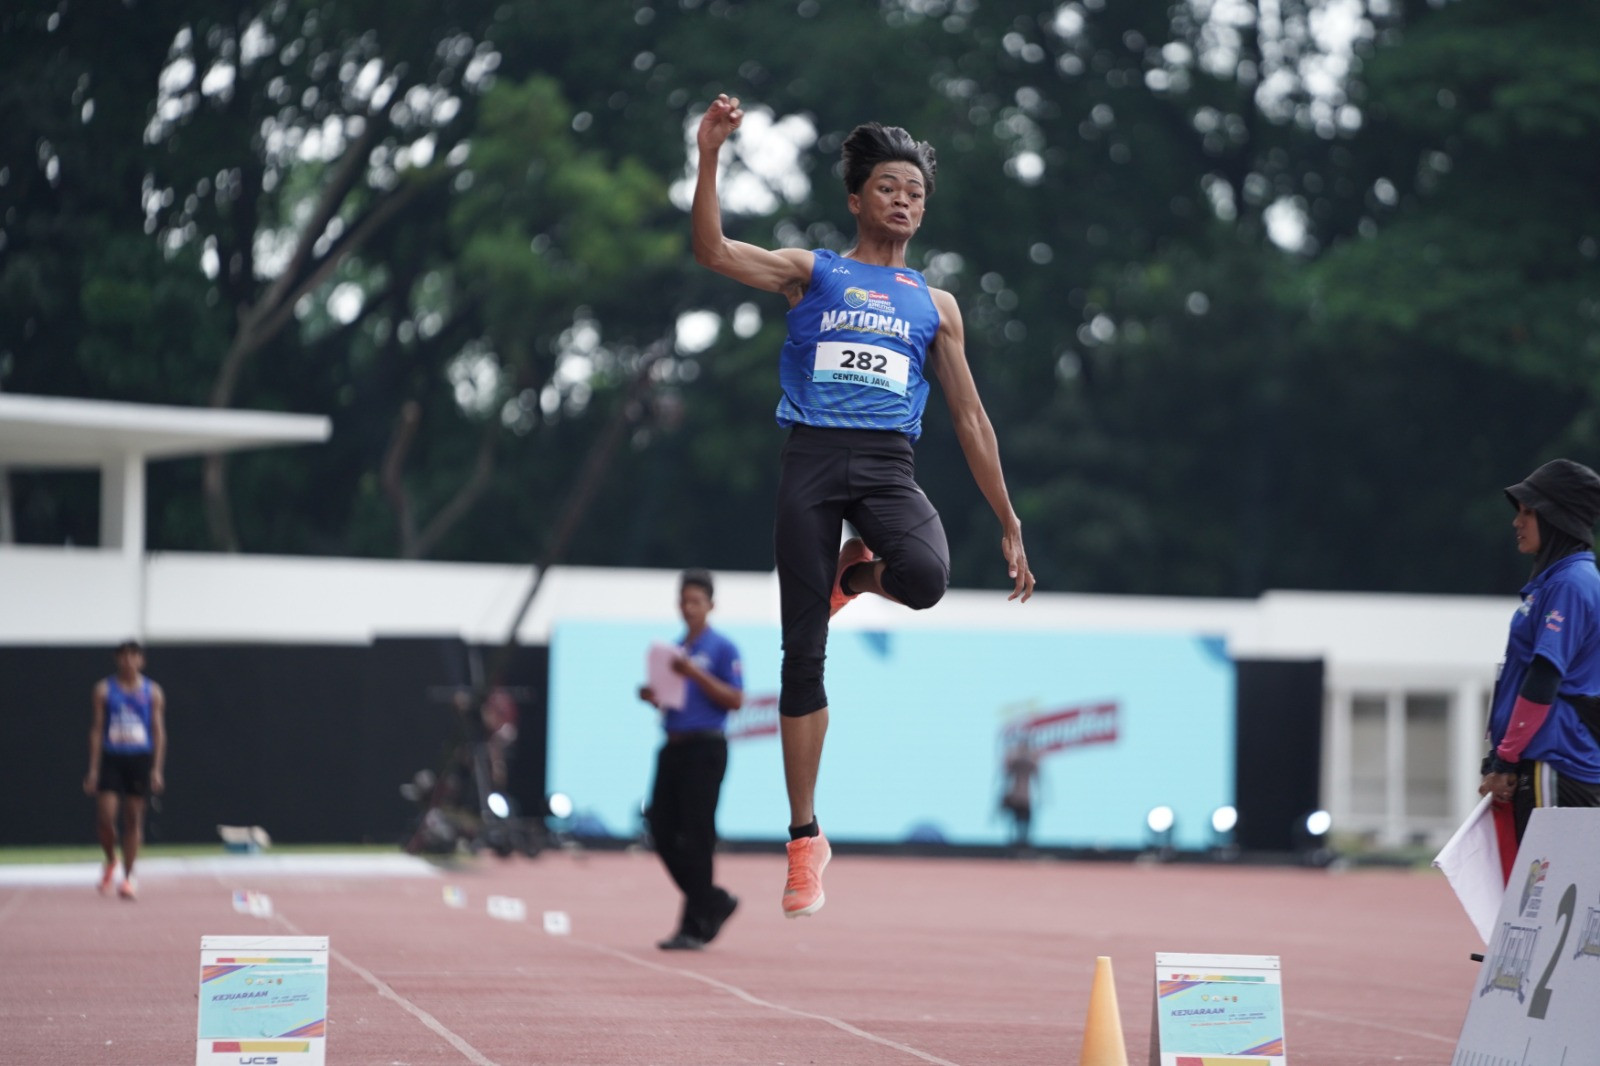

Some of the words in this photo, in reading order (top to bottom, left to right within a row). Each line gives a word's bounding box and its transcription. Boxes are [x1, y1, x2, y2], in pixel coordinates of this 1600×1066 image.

[820, 310, 910, 339] NATIONAL
[840, 350, 888, 374] 282
[832, 372, 869, 384] CENTRAL
[870, 377, 890, 388] JAVA
[1527, 883, 1577, 1020] 2
[212, 990, 268, 1002] KEJUARAAN
[1171, 1007, 1225, 1017] KEJUARAAN
[239, 1057, 278, 1065] UCS
